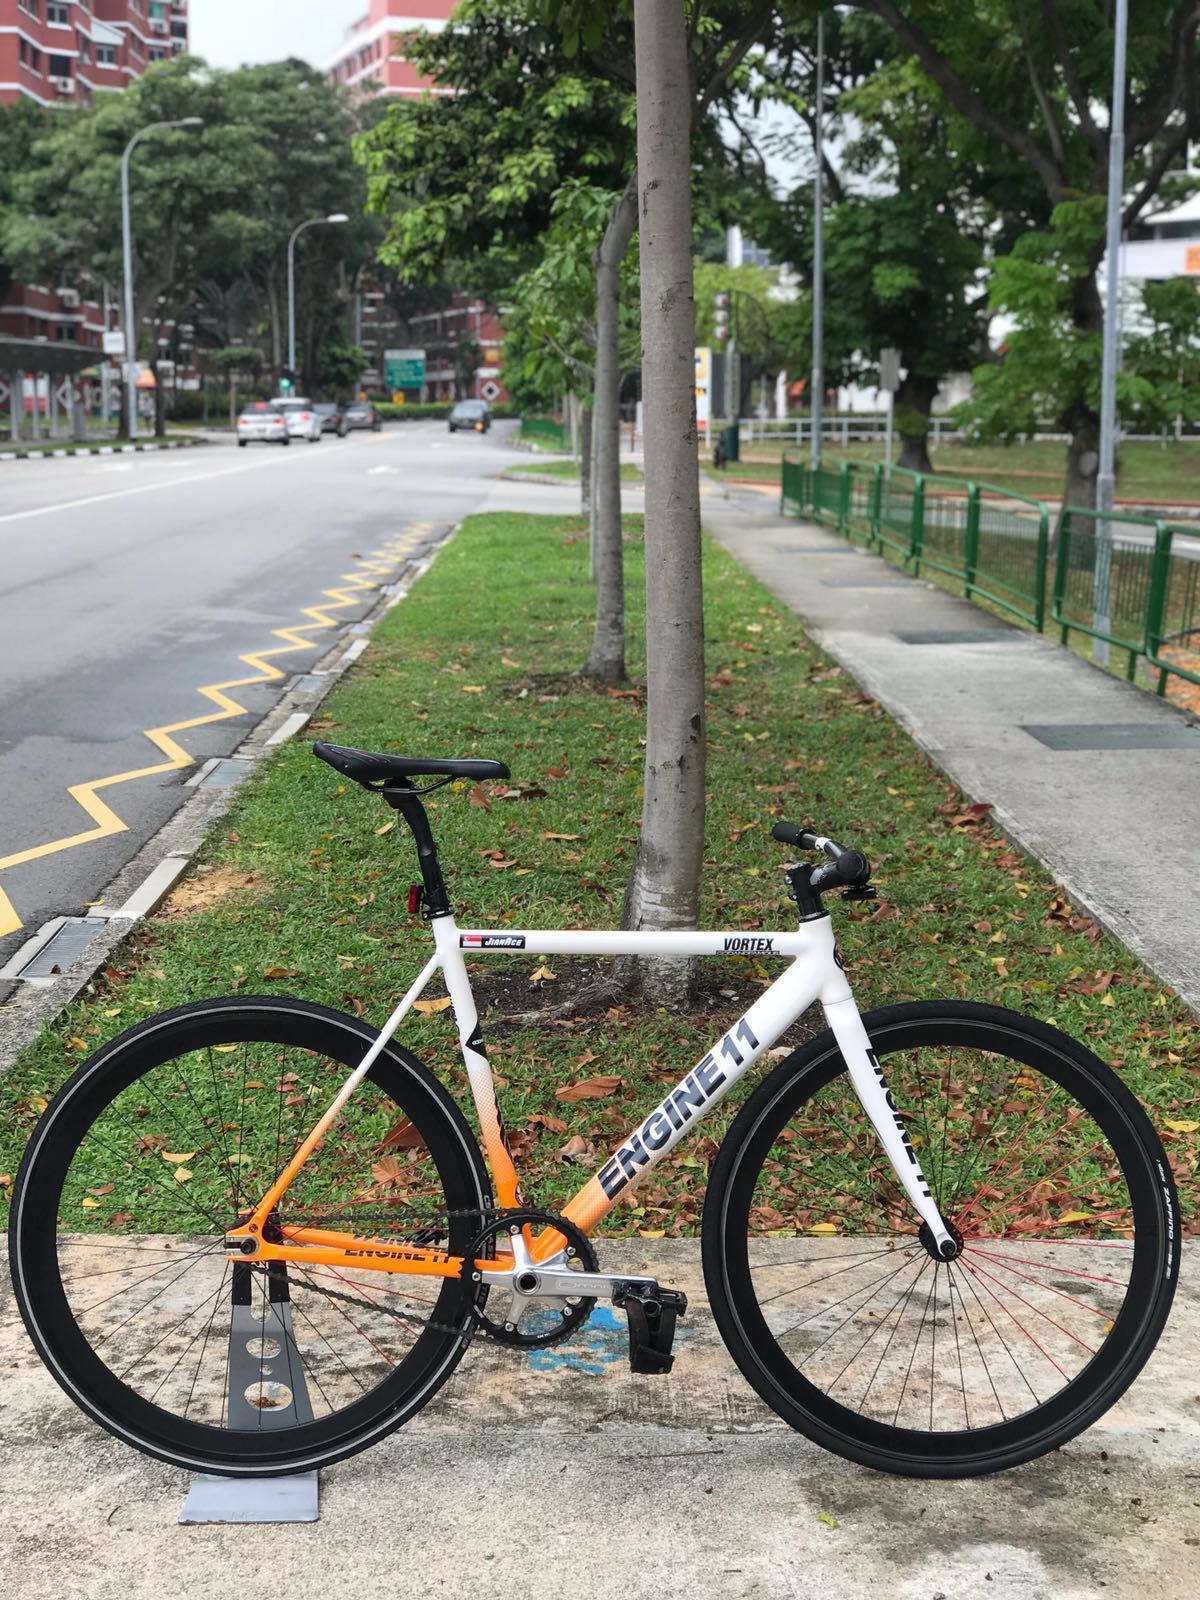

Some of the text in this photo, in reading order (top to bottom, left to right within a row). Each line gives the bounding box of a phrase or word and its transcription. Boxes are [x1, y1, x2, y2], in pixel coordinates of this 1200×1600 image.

[724, 937, 774, 951] VORTEX
[597, 1053, 727, 1200] ENGINE
[720, 1017, 760, 1067] 11
